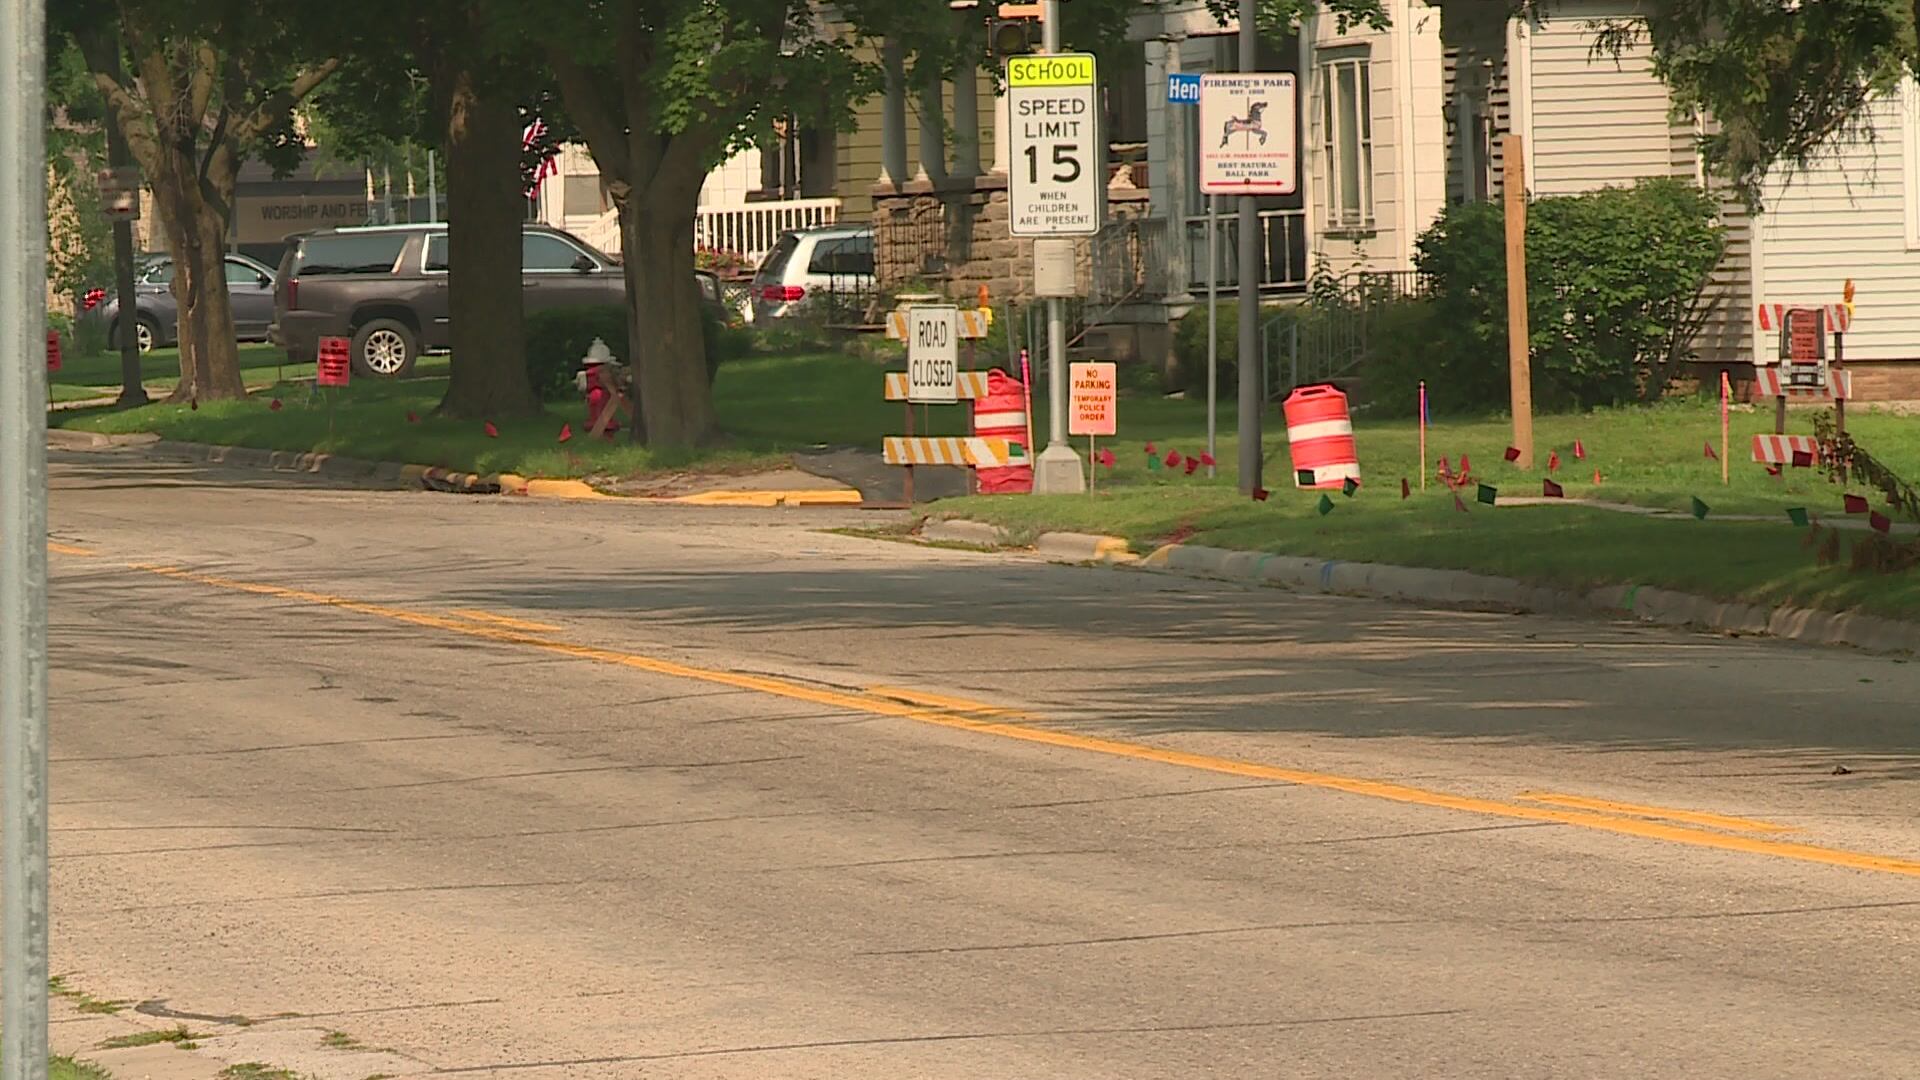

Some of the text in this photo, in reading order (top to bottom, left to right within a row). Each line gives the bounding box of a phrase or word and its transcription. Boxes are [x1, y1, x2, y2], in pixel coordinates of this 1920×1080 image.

[1013, 62, 1090, 80] SCHOOL
[1168, 77, 1200, 100] Hen
[1263, 79, 1292, 88] PARK
[1018, 98, 1086, 116] SPEED
[1024, 121, 1081, 138] LIMIT
[1024, 143, 1082, 184] 15
[1240, 161, 1279, 169] NATURAL
[1225, 170, 1246, 178] BALL
[1039, 191, 1068, 201] WHEN
[261, 204, 318, 220] WORSHIP
[320, 203, 347, 219] AND
[1028, 203, 1079, 213] CHILDREN
[1019, 214, 1090, 226] ARE PRESENT
[918, 320, 948, 348] ROAD
[912, 359, 954, 387] CLOSED
[1086, 369, 1099, 379] NO
[1074, 380, 1112, 390] PARKING
[1073, 395, 1112, 403] TEMPORARY
[1079, 404, 1106, 412] POLICE
[1079, 413, 1106, 421] ORDER
